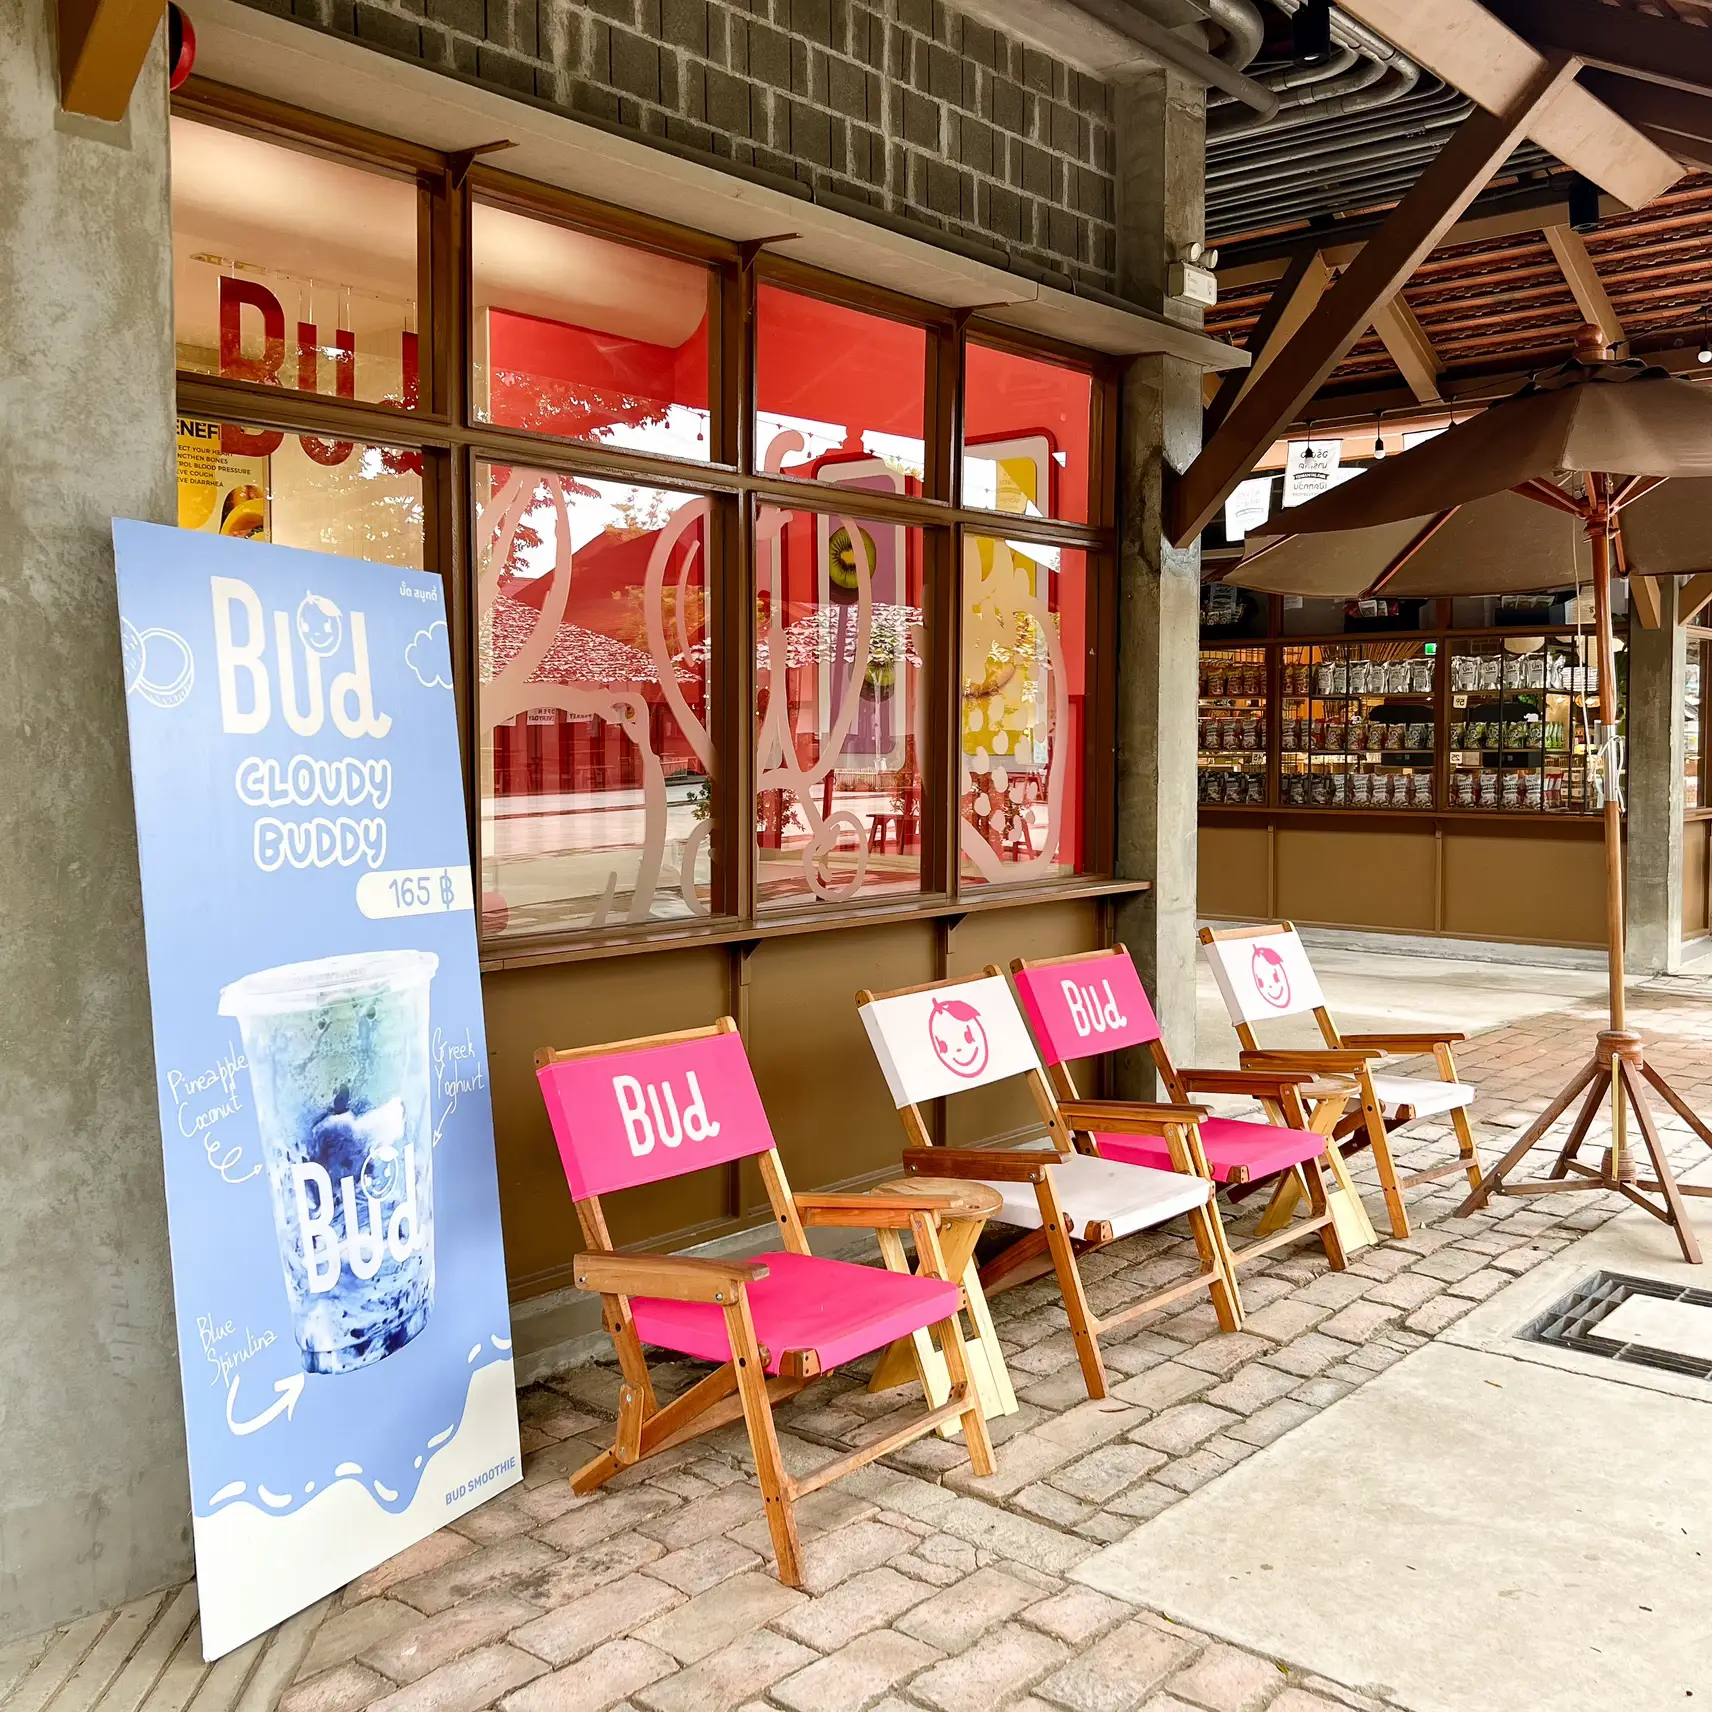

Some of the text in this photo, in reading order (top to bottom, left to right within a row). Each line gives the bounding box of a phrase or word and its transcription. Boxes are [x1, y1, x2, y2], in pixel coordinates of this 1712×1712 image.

[190, 470, 214, 478] COUGH
[190, 478, 224, 487] DIARRHEA
[193, 463, 217, 471] BLOOD
[218, 465, 251, 476] PRESSURE
[206, 456, 228, 465] BONES
[235, 754, 392, 810] CLOUDY
[253, 816, 387, 872] BUDDY
[389, 876, 431, 908] 165
[432, 1026, 476, 1062] Greek
[167, 1040, 249, 1104] Pineapple
[434, 1059, 485, 1114] Yoghurt
[178, 1084, 243, 1138] Coconut
[196, 1312, 236, 1353] Blue
[207, 1325, 278, 1388] Spirulina
[445, 1456, 516, 1505] BUD SMOOTHIE
